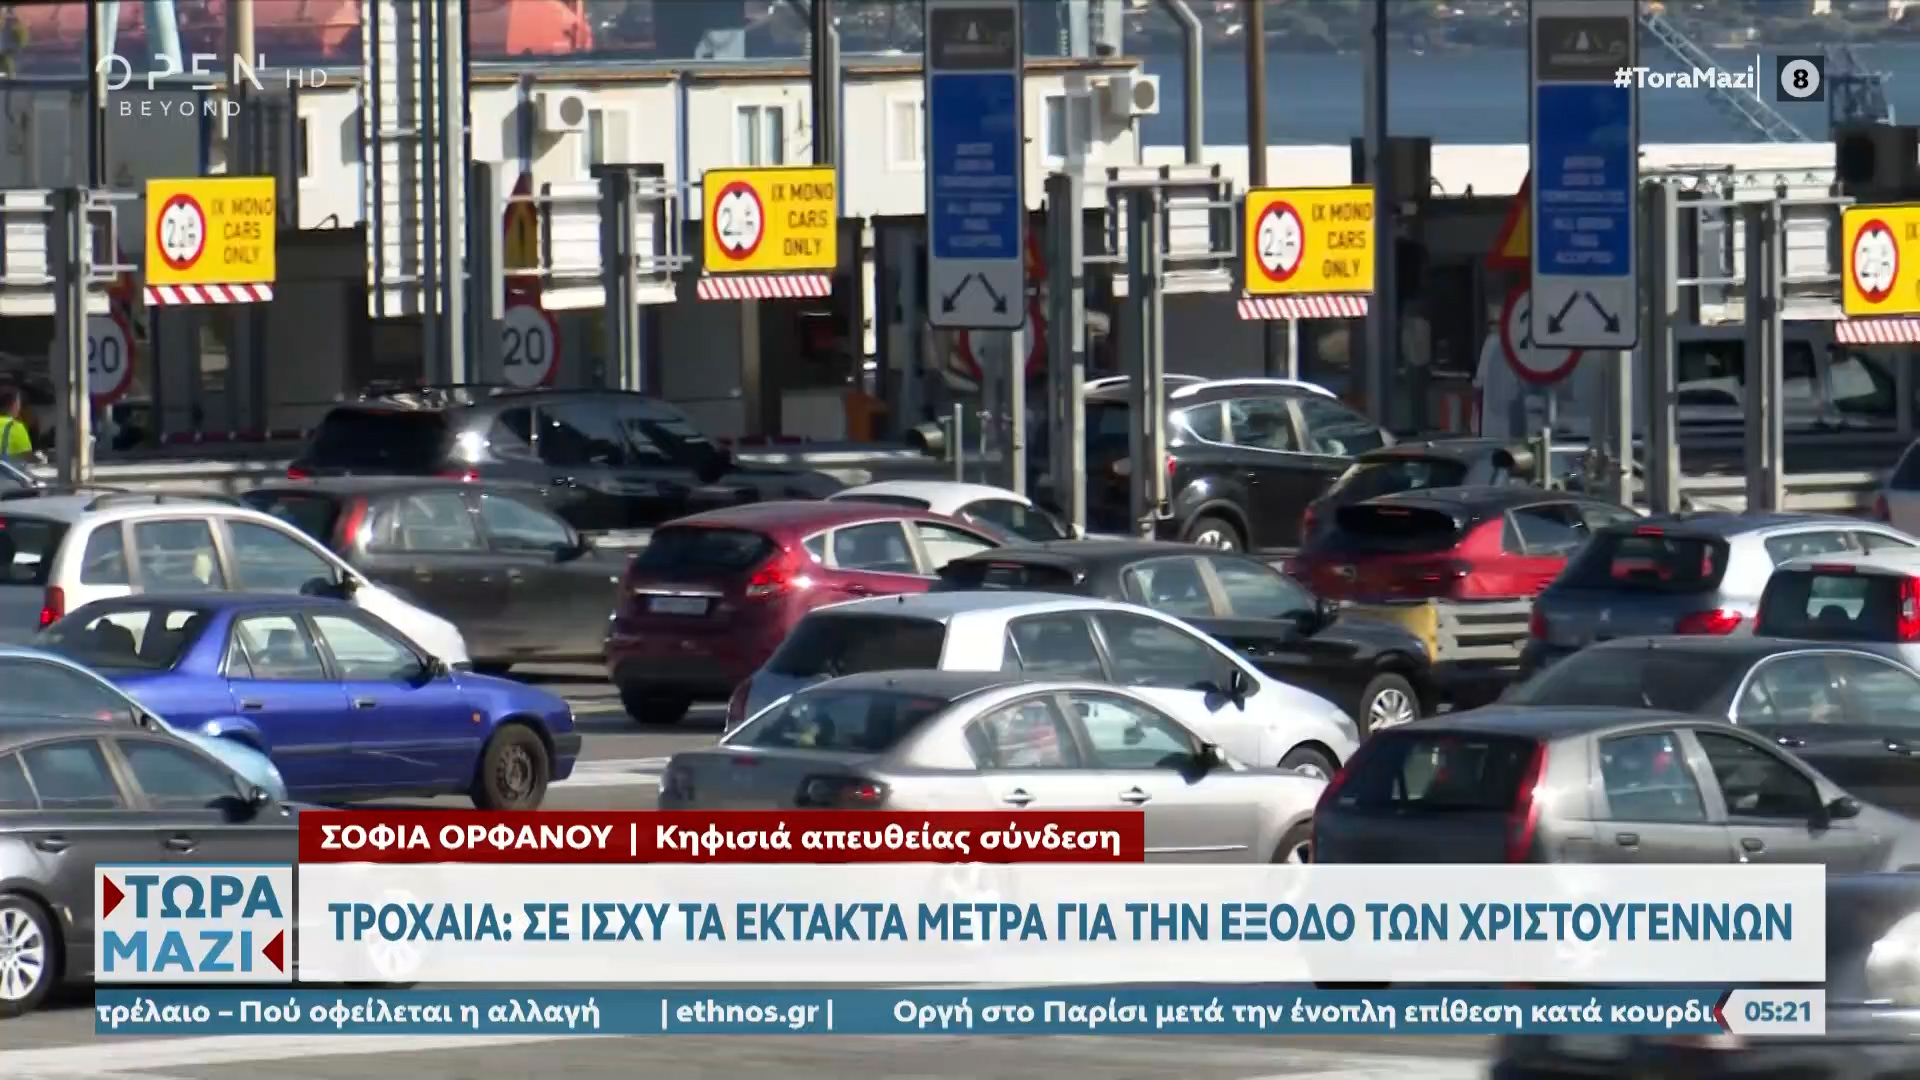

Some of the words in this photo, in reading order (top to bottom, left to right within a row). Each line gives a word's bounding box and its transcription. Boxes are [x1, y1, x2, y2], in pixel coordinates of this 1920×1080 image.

[787, 209, 829, 229] CARS
[223, 221, 261, 240] CARS
[1326, 230, 1367, 250] CARS
[223, 246, 261, 265] ONLY
[783, 237, 823, 257] ONLY
[1322, 258, 1361, 279] ONLY
[501, 326, 546, 366] 20
